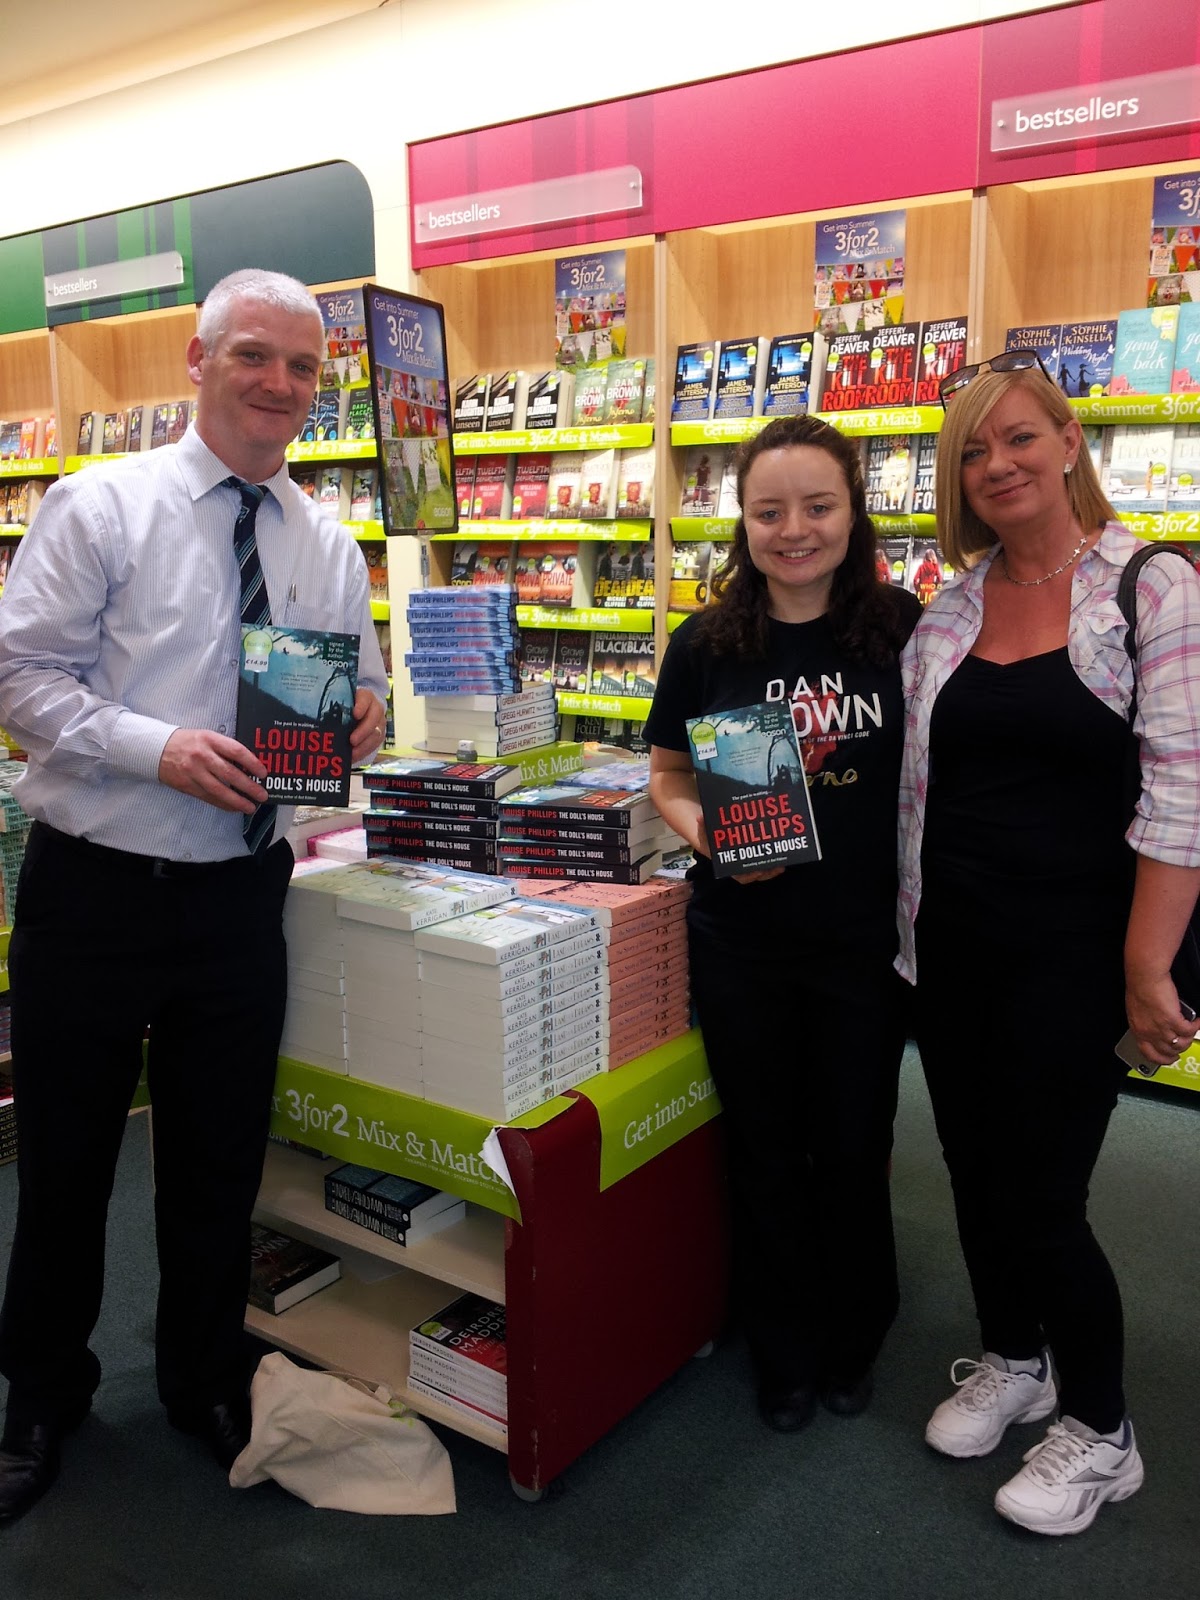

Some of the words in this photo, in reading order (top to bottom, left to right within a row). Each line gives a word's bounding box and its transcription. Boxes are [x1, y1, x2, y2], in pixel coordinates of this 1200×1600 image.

[1015, 97, 1140, 133] bestsellers
[1164, 181, 1179, 190] Get
[428, 204, 500, 229] bestsellers
[823, 225, 835, 233] Get
[849, 220, 875, 229] Summer
[835, 228, 879, 256] 3for2
[571, 265, 605, 289] 3for2
[53, 278, 97, 297] bestsellers
[327, 300, 354, 321] 3for2
[374, 297, 386, 310] Get
[397, 304, 419, 319] Summer
[877, 326, 907, 338] JEFFERY
[929, 321, 958, 332] JEFFERY
[1016, 328, 1051, 339] SOPHIE
[1071, 325, 1107, 336] SOPHIE
[387, 315, 424, 357] 3for2
[834, 334, 861, 345] JEFFERY
[873, 333, 915, 348] DEAVER
[924, 327, 966, 344] DEAVER
[1065, 332, 1112, 344] KINSELLA
[830, 341, 870, 354] DEAVER
[938, 340, 963, 359] THE
[1009, 338, 1056, 348] KINSELLA
[1119, 338, 1159, 358] going
[842, 354, 867, 370] THE
[886, 347, 913, 363] THE
[1132, 354, 1168, 371] back
[778, 375, 800, 384] JAMES
[831, 366, 867, 391] KILL
[874, 362, 913, 385] KILL
[614, 378, 634, 388] DAN
[719, 385, 752, 395] PATTERSON
[726, 379, 747, 388] JAMES
[770, 381, 807, 391] PATTERSON
[606, 386, 641, 400] BROWN
[865, 381, 914, 405] ROOM
[575, 394, 605, 407] BROWN
[1091, 403, 1157, 417] Summer
[456, 421, 480, 429] unseen
[488, 417, 511, 427] unseen
[527, 418, 553, 428] unseen
[840, 415, 865, 428] Mix
[880, 412, 921, 427] Match
[703, 423, 723, 437] Get
[488, 435, 526, 447] Summer
[529, 430, 557, 450] 3for2
[559, 432, 578, 444] Mix
[704, 522, 722, 535] Get
[879, 518, 919, 532] Match
[1152, 514, 1199, 539] 3for2
[590, 612, 620, 625] Match
[526, 645, 549, 655] Grave
[561, 646, 584, 657] Grave
[322, 659, 349, 669] eason
[766, 672, 844, 702] DAN
[563, 698, 582, 708] Mix
[592, 700, 622, 712] Match
[791, 693, 882, 738] OWN
[255, 727, 335, 753] LOUISE
[761, 728, 786, 738] eason
[838, 732, 854, 740] VINCI
[854, 730, 870, 738] CODE
[257, 752, 343, 777] HILLIPS
[537, 757, 549, 777] &
[266, 776, 303, 791] DOLL'S
[306, 779, 342, 793] HOUSE
[502, 809, 525, 817] LOUISE
[528, 811, 557, 819] PHILLIPS
[570, 812, 586, 820] DOLL'S
[587, 813, 605, 821] HOUSE
[719, 793, 792, 826] LOUISE
[713, 814, 805, 849] PHILLIPS
[717, 850, 737, 864] THE
[739, 843, 773, 860] DOLL'S
[773, 836, 808, 854] HOUSE
[507, 866, 531, 874] LOUISE
[534, 867, 564, 876] PHILLIPS
[578, 869, 595, 877] DOLL'S
[596, 870, 614, 878] HOUSE
[416, 912, 448, 926] KERRIGAN
[425, 908, 438, 916] KATE
[500, 945, 531, 960] KERRIGAN
[624, 1114, 653, 1149] Get
[655, 1096, 686, 1130] into
[285, 1089, 350, 1138] 3for2
[356, 1116, 403, 1153] Mix
[405, 1131, 427, 1160] &
[430, 1138, 507, 1188] Matc
[449, 1306, 506, 1345] DEIRDRE
[459, 1318, 507, 1352] MADDE
